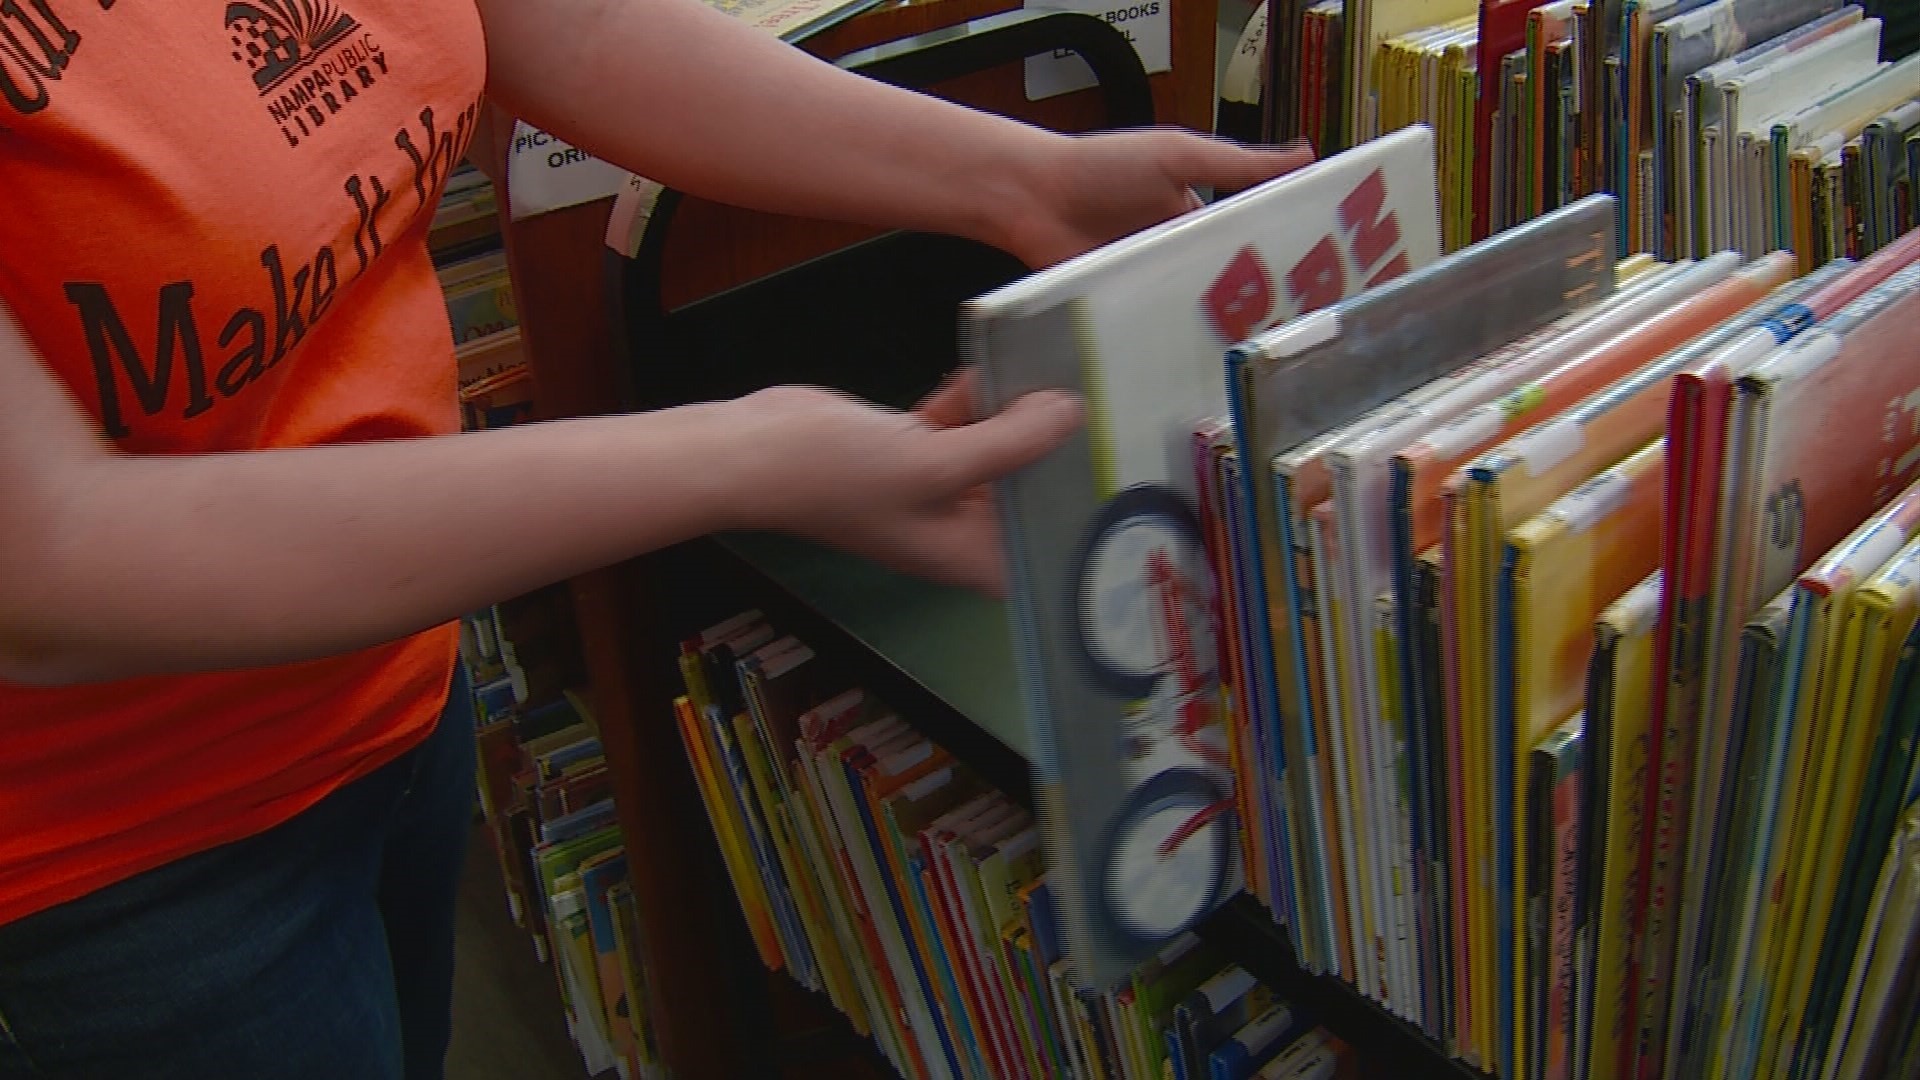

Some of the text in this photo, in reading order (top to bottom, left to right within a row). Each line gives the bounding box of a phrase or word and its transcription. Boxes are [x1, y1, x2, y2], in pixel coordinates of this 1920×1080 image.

[1105, 2, 1161, 24] BOOKS
[281, 51, 389, 149] LIBRARY
[515, 131, 557, 154] PIC
[548, 147, 592, 168] ORI
[63, 244, 338, 440] Make
[344, 174, 390, 281] It
